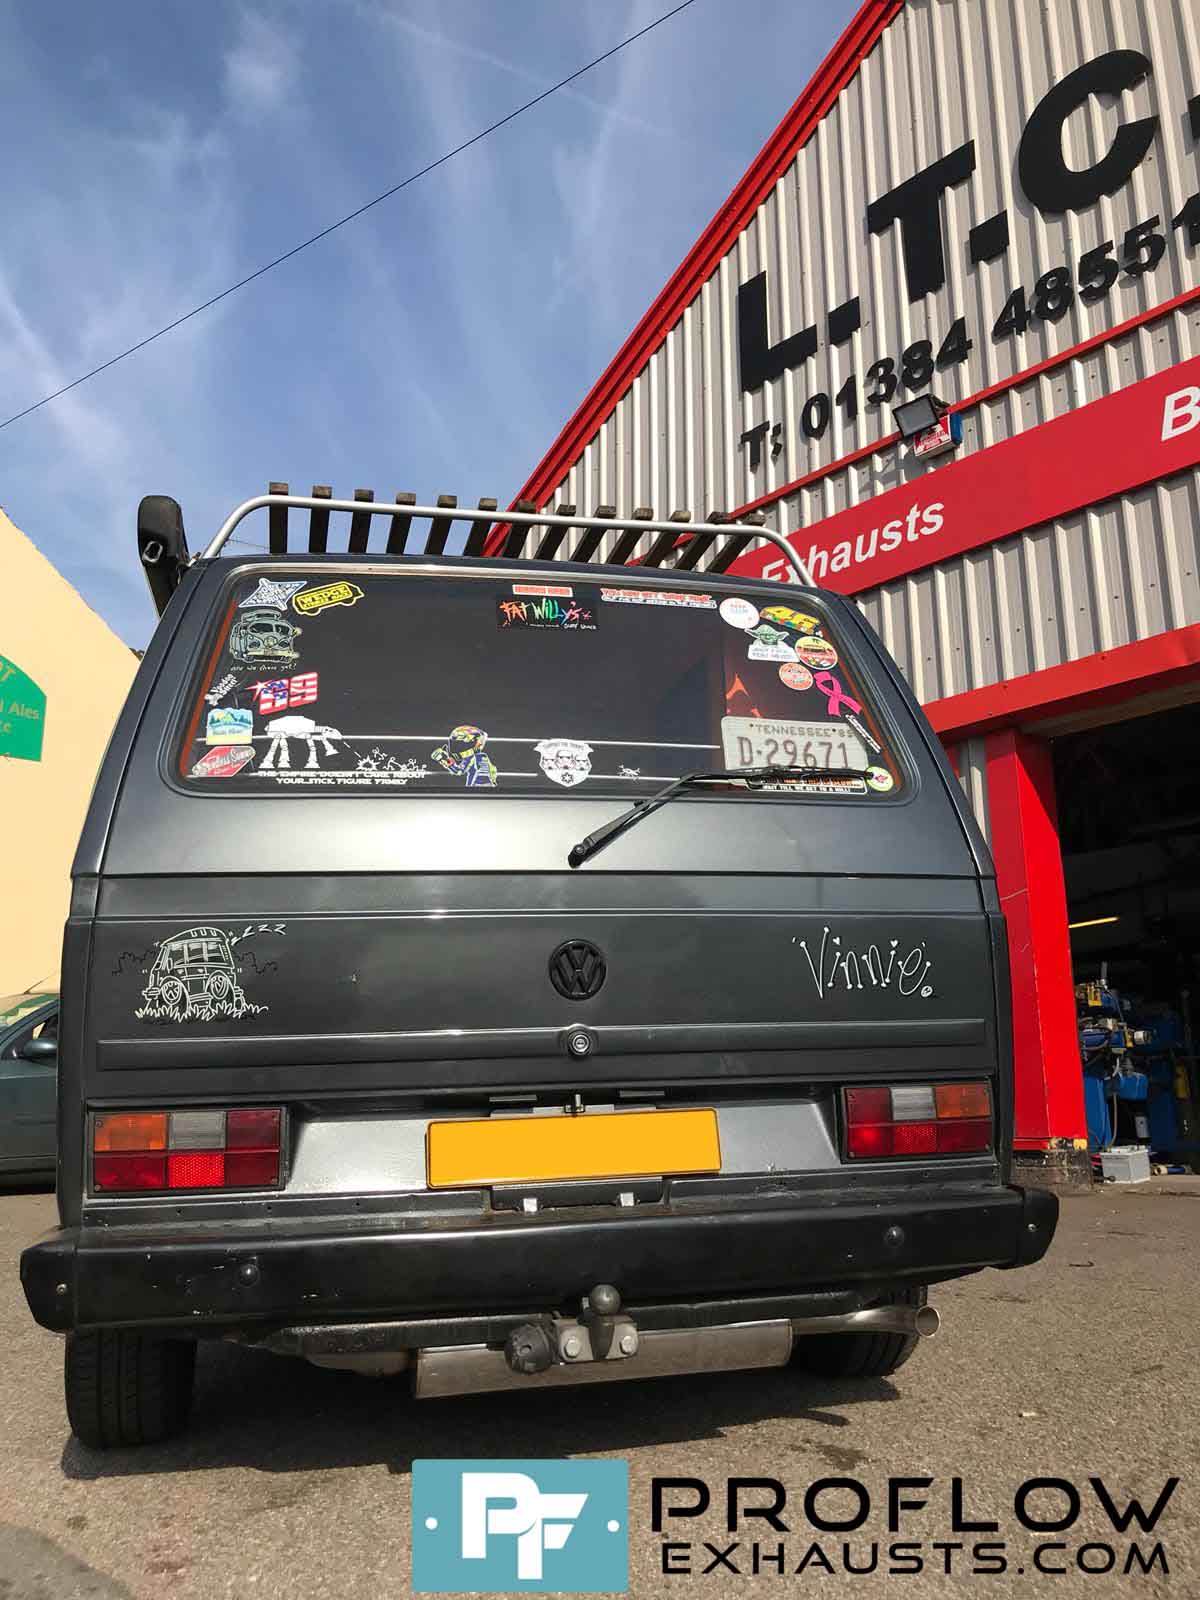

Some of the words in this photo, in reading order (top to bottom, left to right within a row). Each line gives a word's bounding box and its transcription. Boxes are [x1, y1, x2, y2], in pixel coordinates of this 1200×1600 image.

[801, 316, 973, 440] 01384
[761, 502, 945, 585] Exhausts
[755, 725, 832, 738] TENNESSEE
